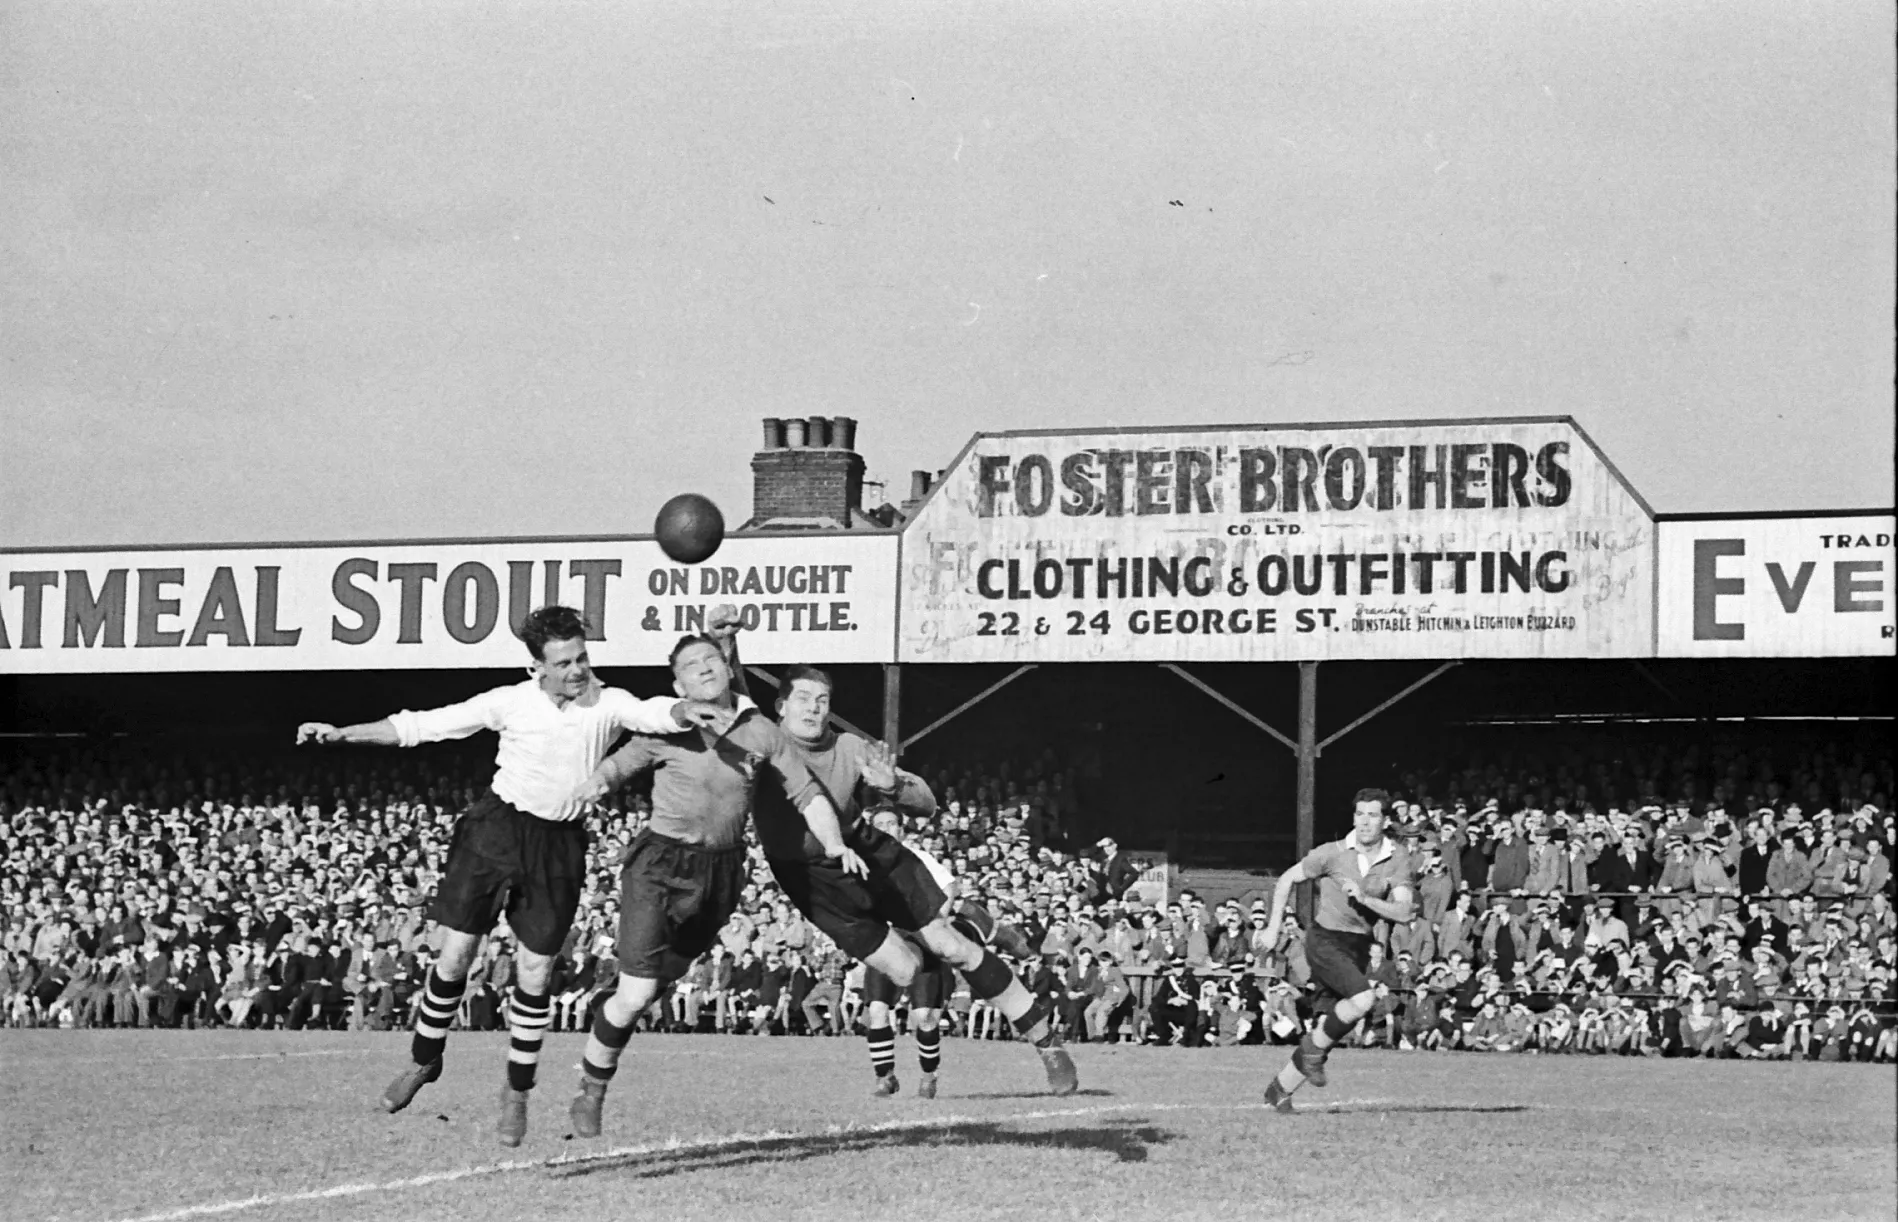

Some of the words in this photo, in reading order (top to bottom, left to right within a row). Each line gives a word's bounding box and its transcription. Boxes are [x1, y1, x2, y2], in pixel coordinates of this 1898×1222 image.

[978, 449, 1215, 518] FOSTER
[1239, 441, 1572, 513] BROTHERS
[1227, 524, 1257, 536] CO.
[1265, 524, 1304, 535] LTD.
[1820, 534, 1896, 548] TRAD
[648, 567, 690, 596] ON
[700, 565, 852, 595] DRAUGHT
[976, 556, 1215, 600] CLOTHING
[1227, 567, 1249, 597] &
[1257, 550, 1569, 596] OUTFITTING
[332, 557, 622, 645] STOUT
[641, 605, 661, 631] &
[674, 604, 706, 632] IN
[736, 602, 858, 631] OTTLE.
[976, 611, 1020, 636] 22
[1034, 616, 1051, 635] &
[1066, 610, 1111, 636] 24
[1128, 608, 1276, 635] GEORGE
[1295, 608, 1340, 634] ST.
[1351, 617, 1411, 631] DUNSTABLE
[1417, 615, 1462, 631] HITCHIN
[1473, 615, 1523, 630] LEIGHTON
[1526, 614, 1576, 631] BUZZARD
